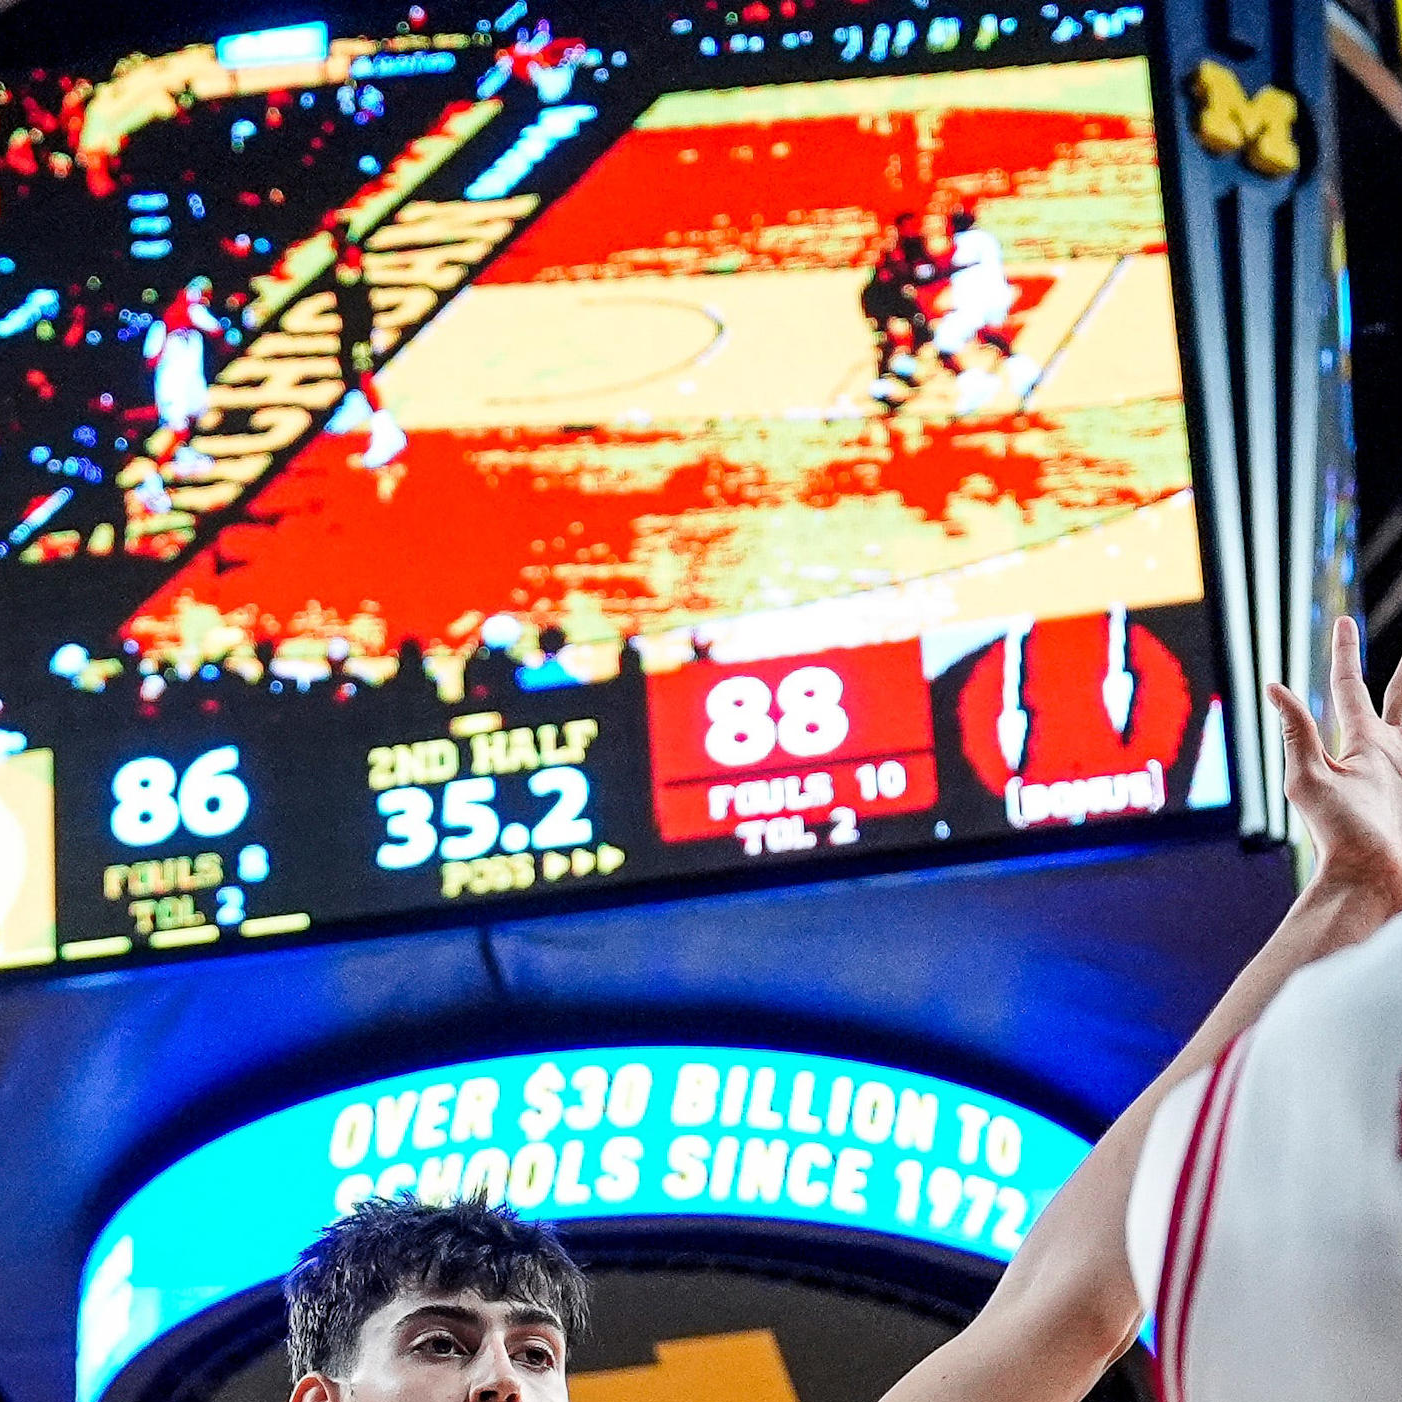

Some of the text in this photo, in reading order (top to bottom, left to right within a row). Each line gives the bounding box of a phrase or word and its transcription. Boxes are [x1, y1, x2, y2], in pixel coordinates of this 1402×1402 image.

[1195, 58, 1300, 180] M
[367, 718, 598, 790] 2ND HALF
[704, 665, 849, 766] 88
[109, 744, 251, 847] 86
[375, 765, 594, 870] 35.2
[828, 806, 861, 846] 2
[855, 759, 907, 801] 10
[328, 1061, 1022, 1177] OVER $30 BILLION TO
[663, 1136, 874, 1214] SINCE
[894, 1159, 1030, 1249] 1972
